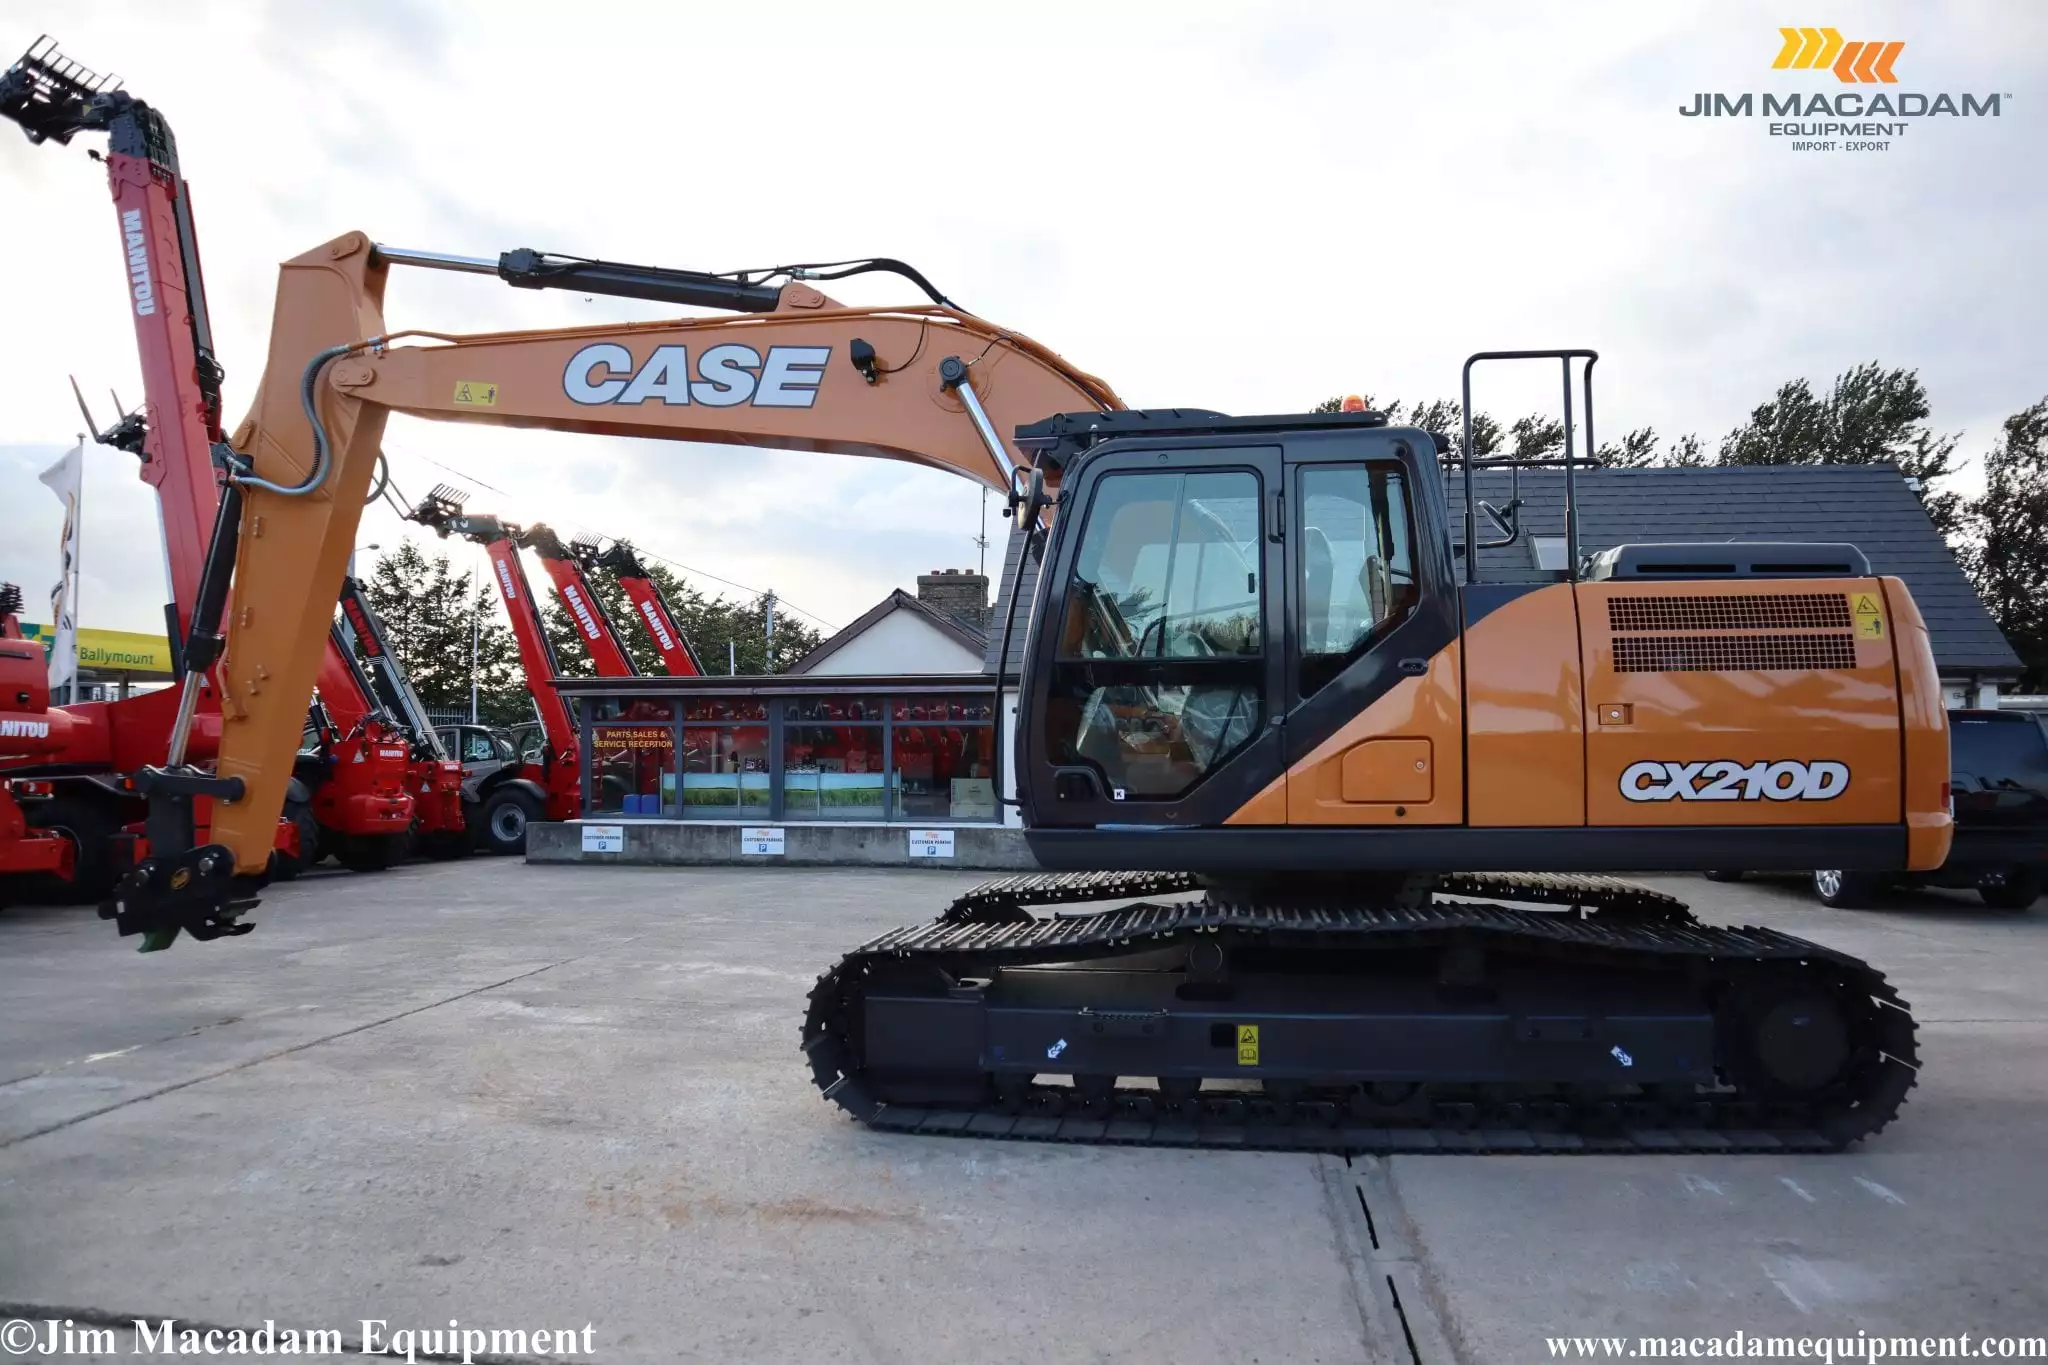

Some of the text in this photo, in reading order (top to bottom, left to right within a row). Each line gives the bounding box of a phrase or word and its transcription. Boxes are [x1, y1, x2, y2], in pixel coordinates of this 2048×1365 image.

[122, 208, 156, 316] MANITOU
[562, 342, 833, 409] CASE
[496, 559, 516, 599] MANITOU
[563, 584, 601, 640] MANITOU
[640, 600, 675, 650] MANITOU
[80, 647, 154, 665] Ballymount
[0, 720, 49, 738] NITOU
[1618, 759, 1851, 802] CX210D
